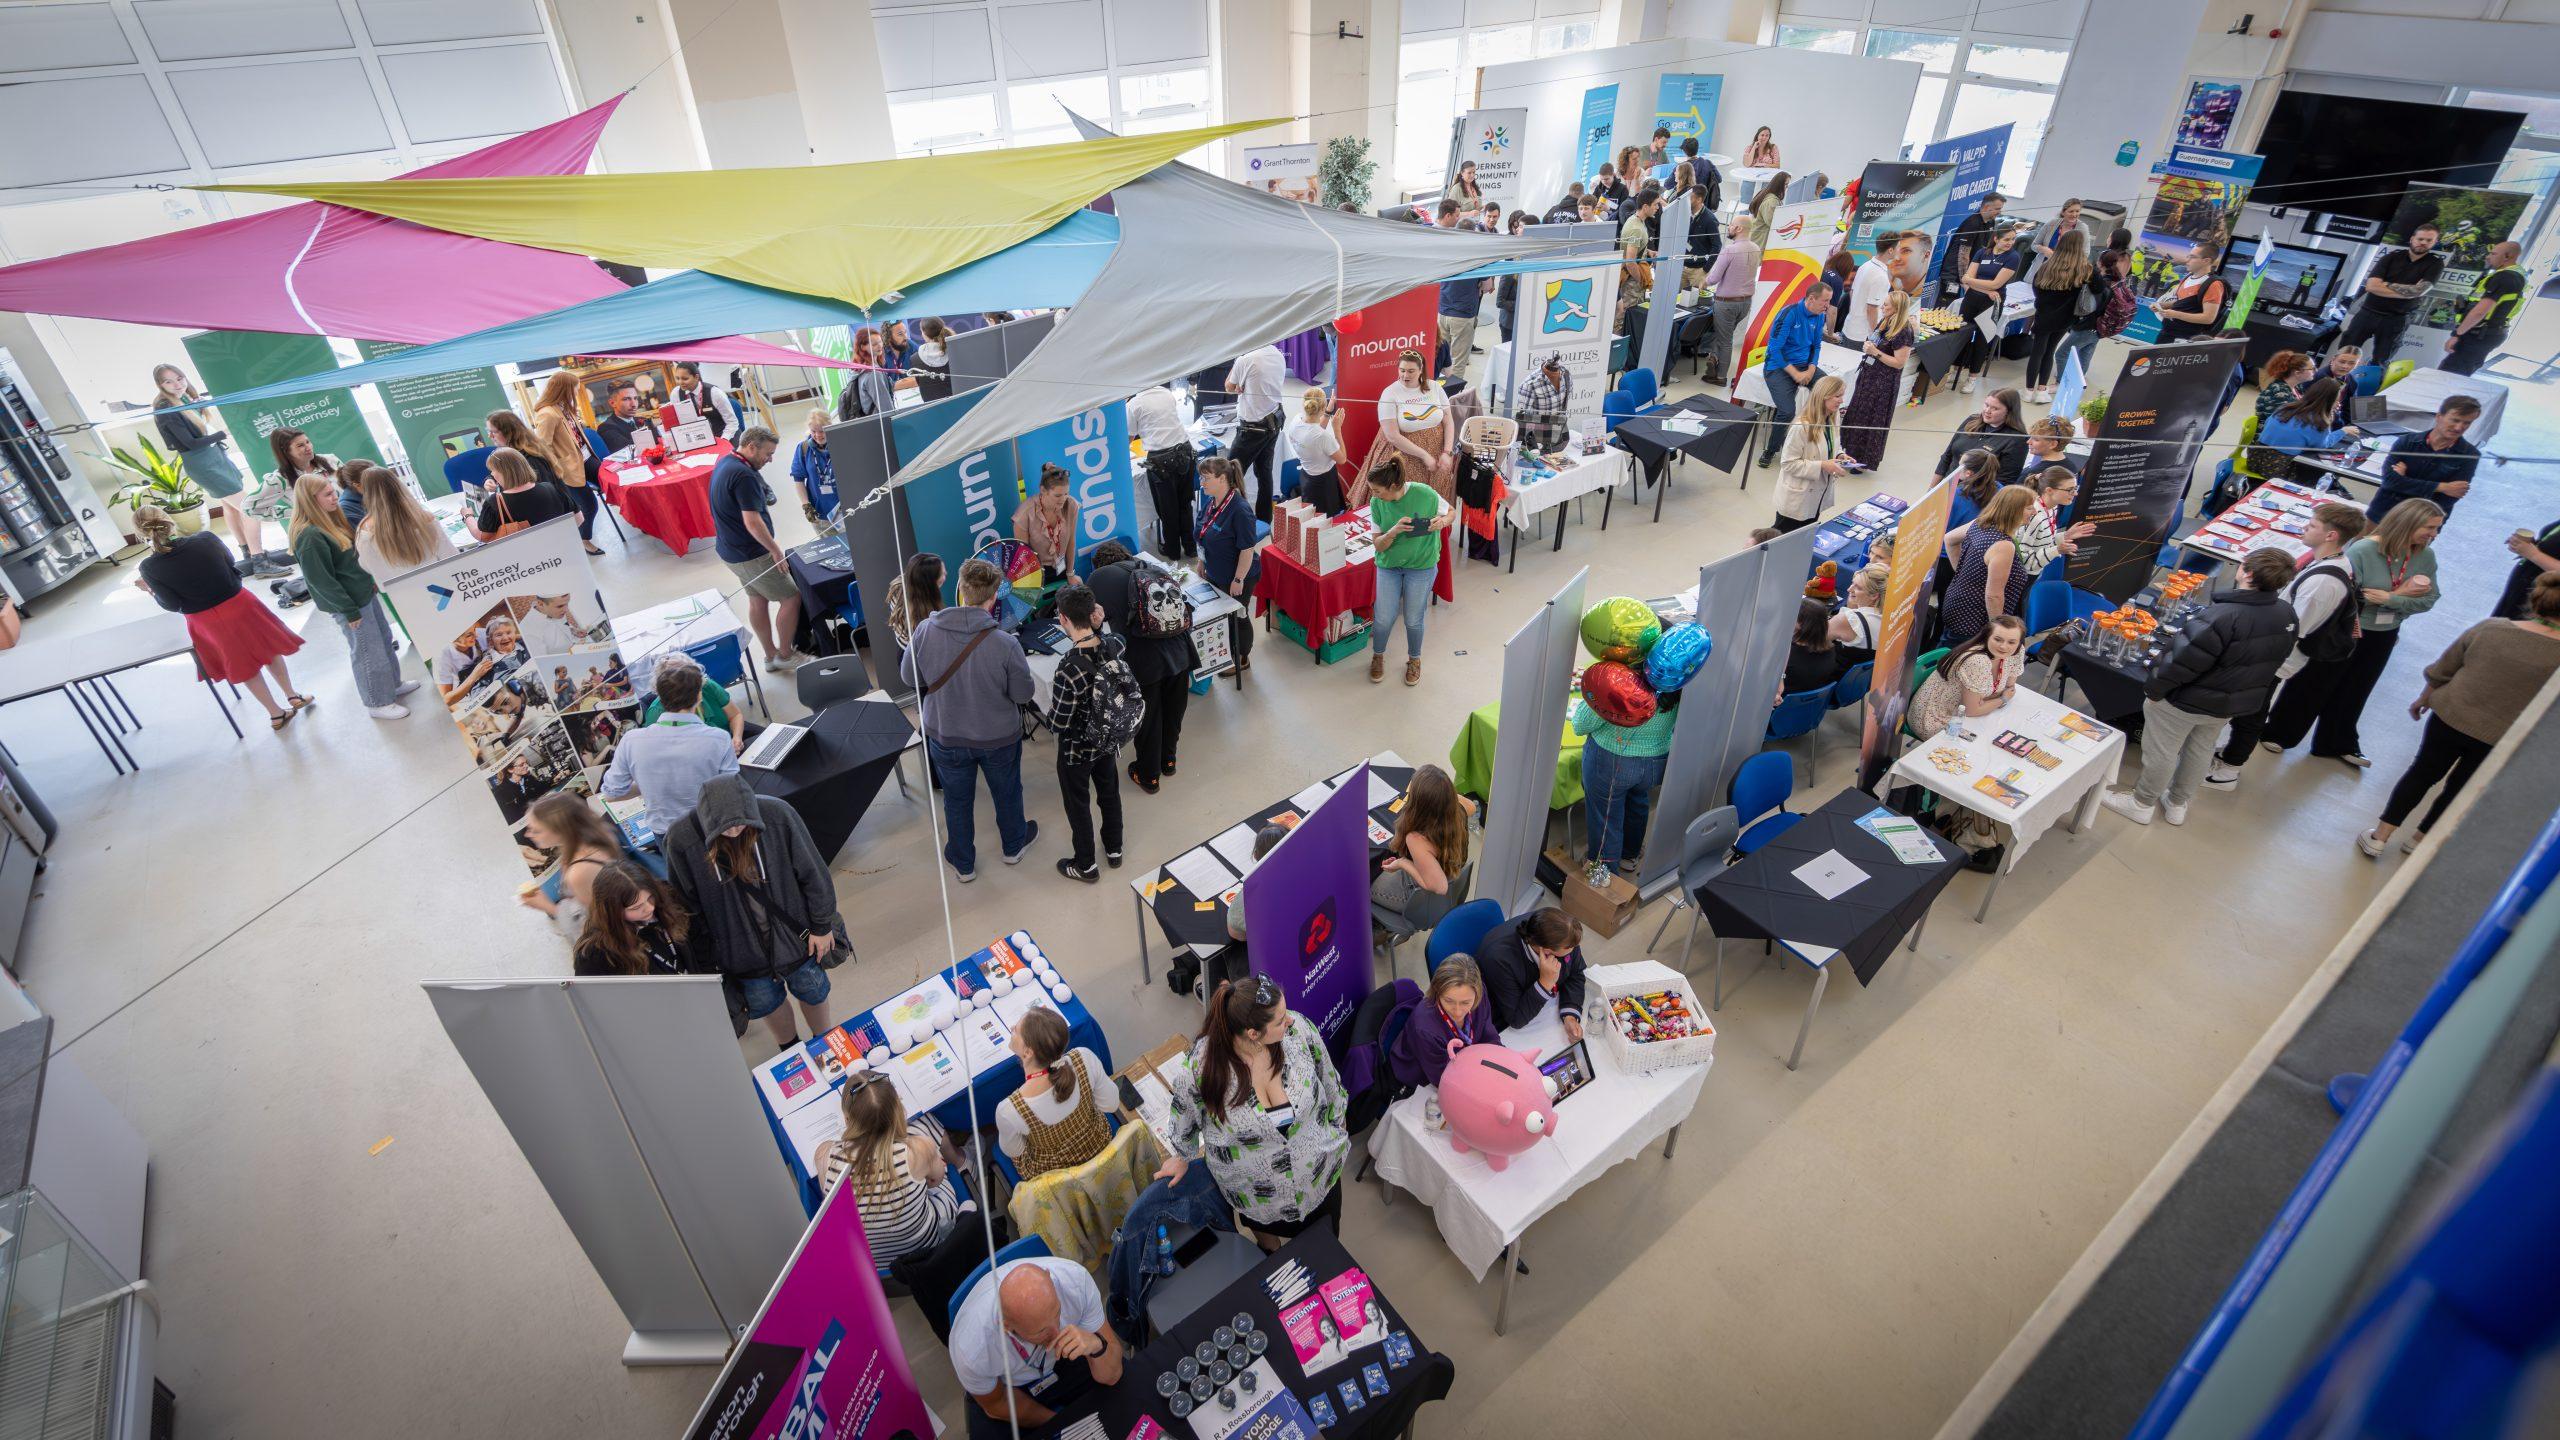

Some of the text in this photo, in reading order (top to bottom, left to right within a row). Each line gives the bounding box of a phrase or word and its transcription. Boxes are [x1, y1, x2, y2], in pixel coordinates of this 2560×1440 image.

[1658, 120, 1670, 128] Go
[1671, 120, 1687, 130] get
[1264, 159, 1282, 168] Grant
[1963, 145, 1987, 162] VALPYS
[2178, 153, 2231, 166] Guernsey Police
[1474, 172, 1518, 181] OMMUNITY
[1475, 162, 1512, 170] UERNSEY
[1867, 190, 1878, 198] Be
[1878, 192, 1895, 200] part
[1896, 190, 1906, 198] of
[1968, 176, 1994, 196] CAREER
[1862, 210, 1888, 218] global
[1864, 201, 1917, 209] extraordinary
[2440, 270, 2476, 284] TERS
[1350, 331, 1426, 358] mourant
[2154, 354, 2208, 368] SUNTERA
[1580, 391, 1595, 400] for
[282, 396, 331, 420] States of
[288, 404, 341, 428] Guernsey
[1064, 408, 1118, 557] lands
[452, 567, 479, 583] The
[457, 562, 521, 591] Guernsey
[463, 556, 562, 602] Apprenticeship
[1302, 950, 1340, 998] International
[1304, 945, 1336, 984] NatWest
[1332, 1281, 1367, 1303] POTENTIAL
[1286, 1300, 1319, 1328] POTENTIAL
[778, 1339, 840, 1440] BAL
[840, 1349, 878, 1426] insurance
[710, 1385, 745, 1440] ation
[852, 1368, 884, 1437] and take
[1222, 1427, 1228, 1436] A
[1228, 1389, 1274, 1429] Rossborough
[1244, 1412, 1272, 1440] YOUR
[1258, 1414, 1284, 1440] EDGE
